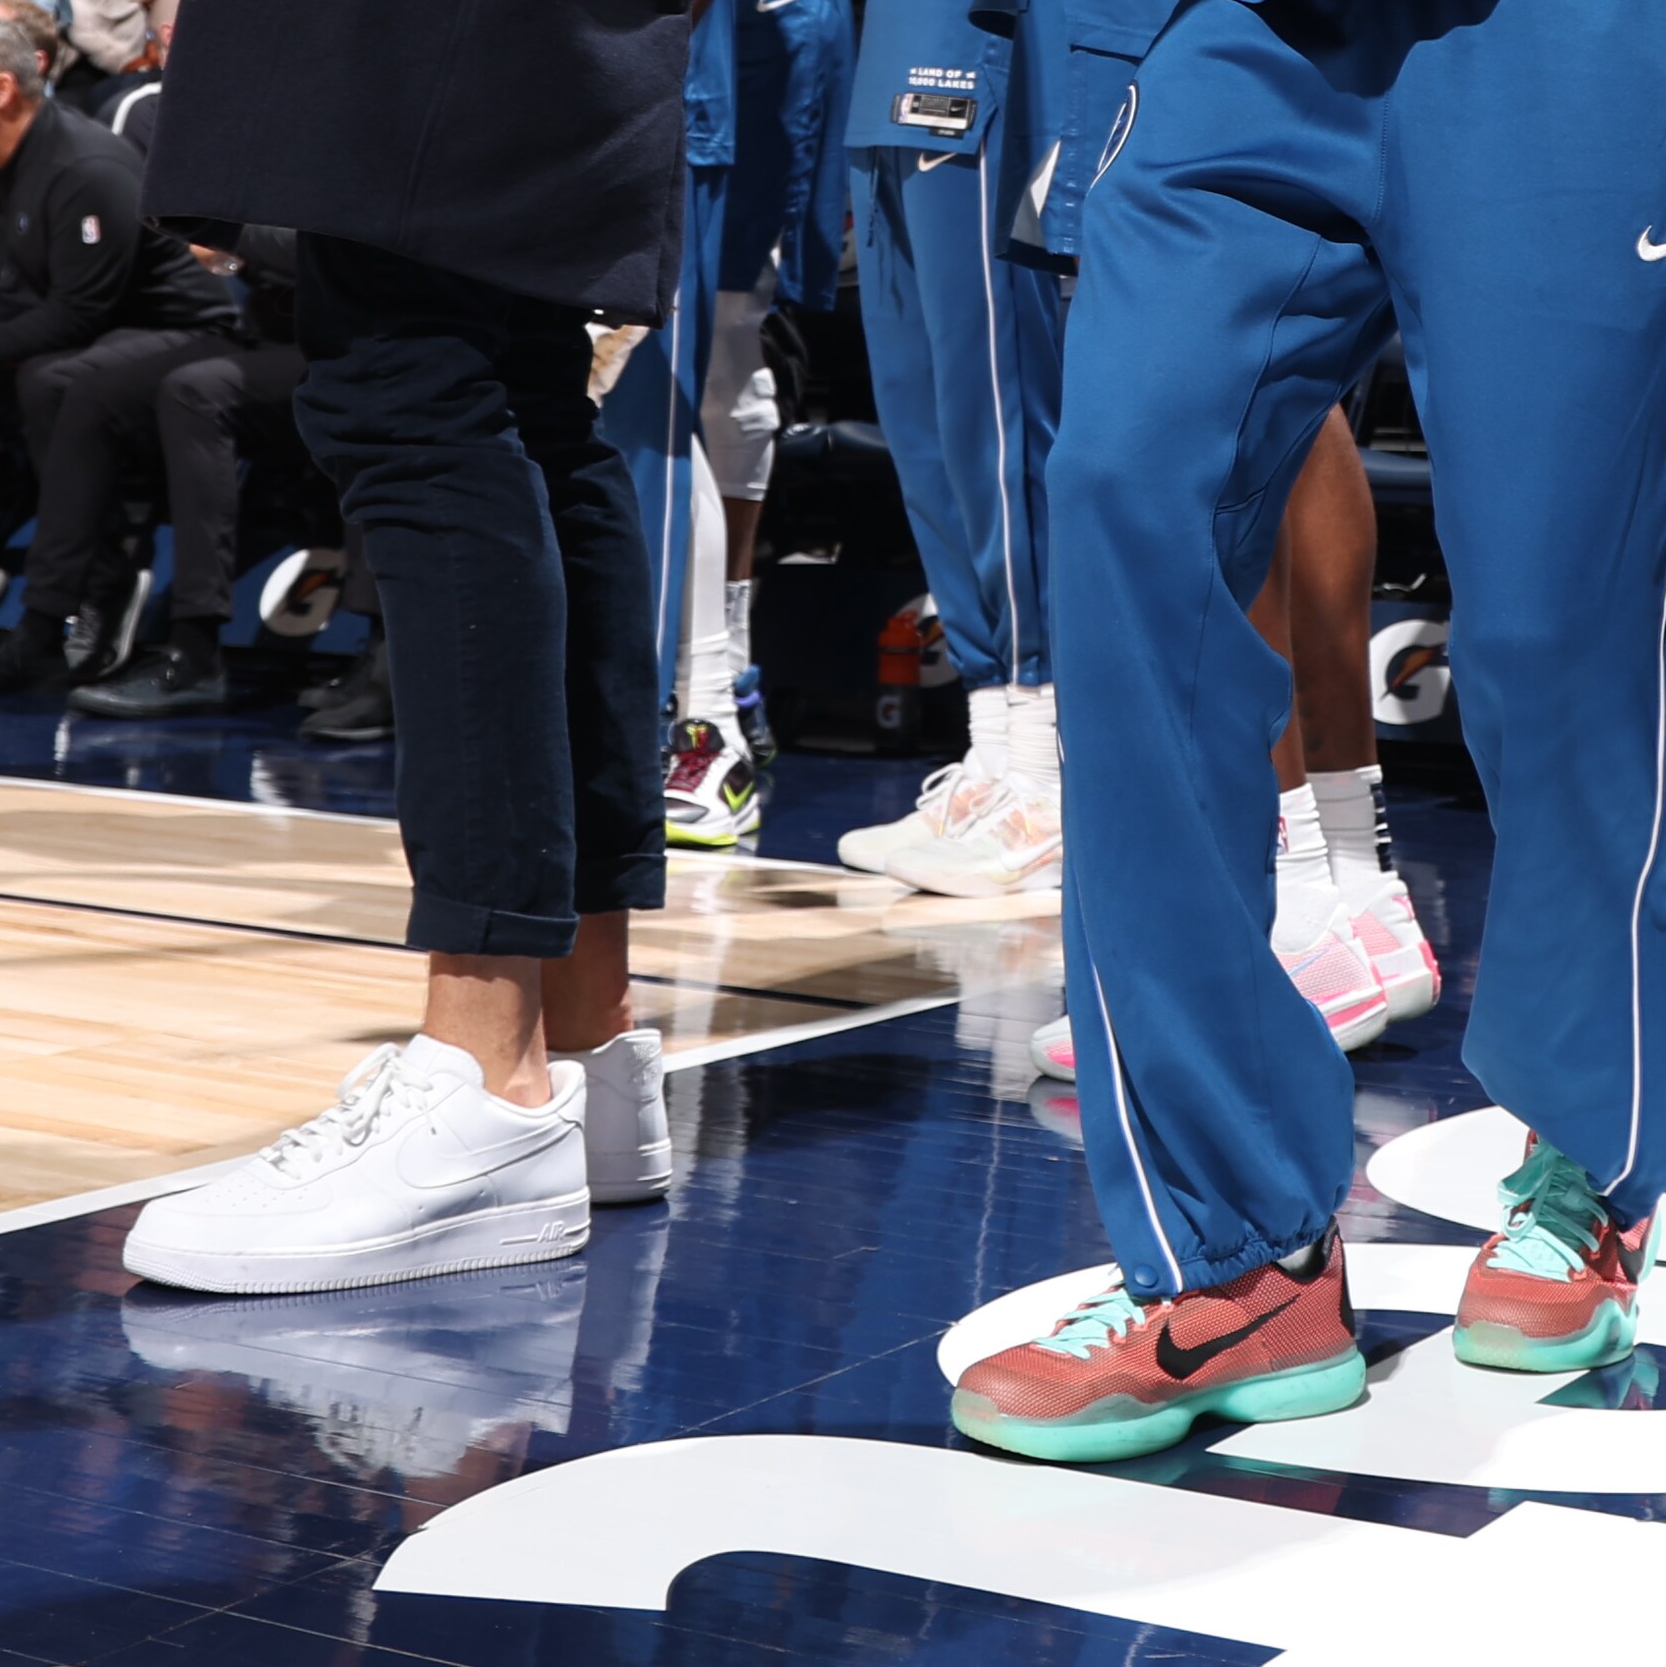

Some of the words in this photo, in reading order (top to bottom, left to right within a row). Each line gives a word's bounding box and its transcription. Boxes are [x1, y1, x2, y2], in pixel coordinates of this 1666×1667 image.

[918, 67, 943, 77] LAND
[946, 69, 962, 79] OF
[938, 79, 976, 90] LAKES
[1369, 619, 1452, 725] G
[537, 1221, 564, 1244] AIR
